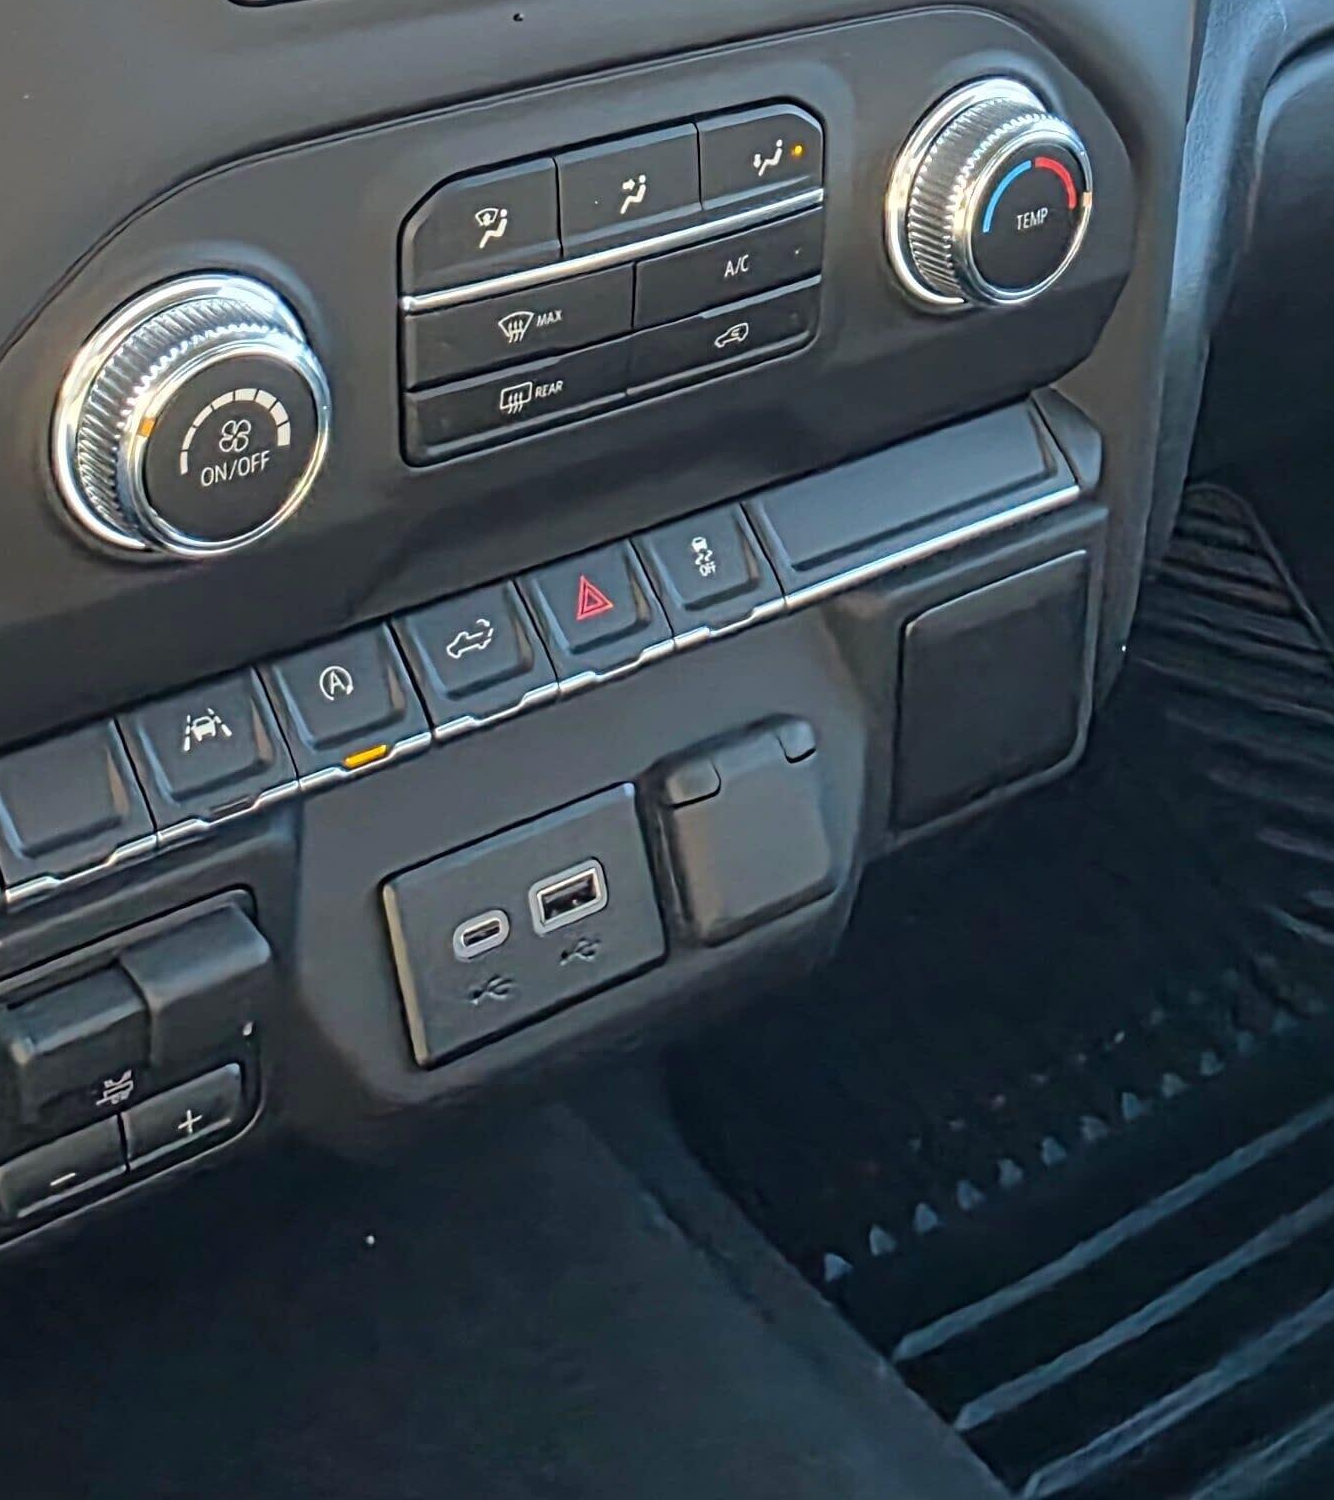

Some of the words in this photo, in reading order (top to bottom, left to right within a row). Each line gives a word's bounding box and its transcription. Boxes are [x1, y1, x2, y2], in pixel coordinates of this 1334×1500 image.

[1017, 207, 1049, 231] TEMP
[724, 254, 750, 278] A/C
[536, 309, 562, 328] MAX
[534, 379, 563, 400] REAR
[200, 450, 271, 488] ON/OFF
